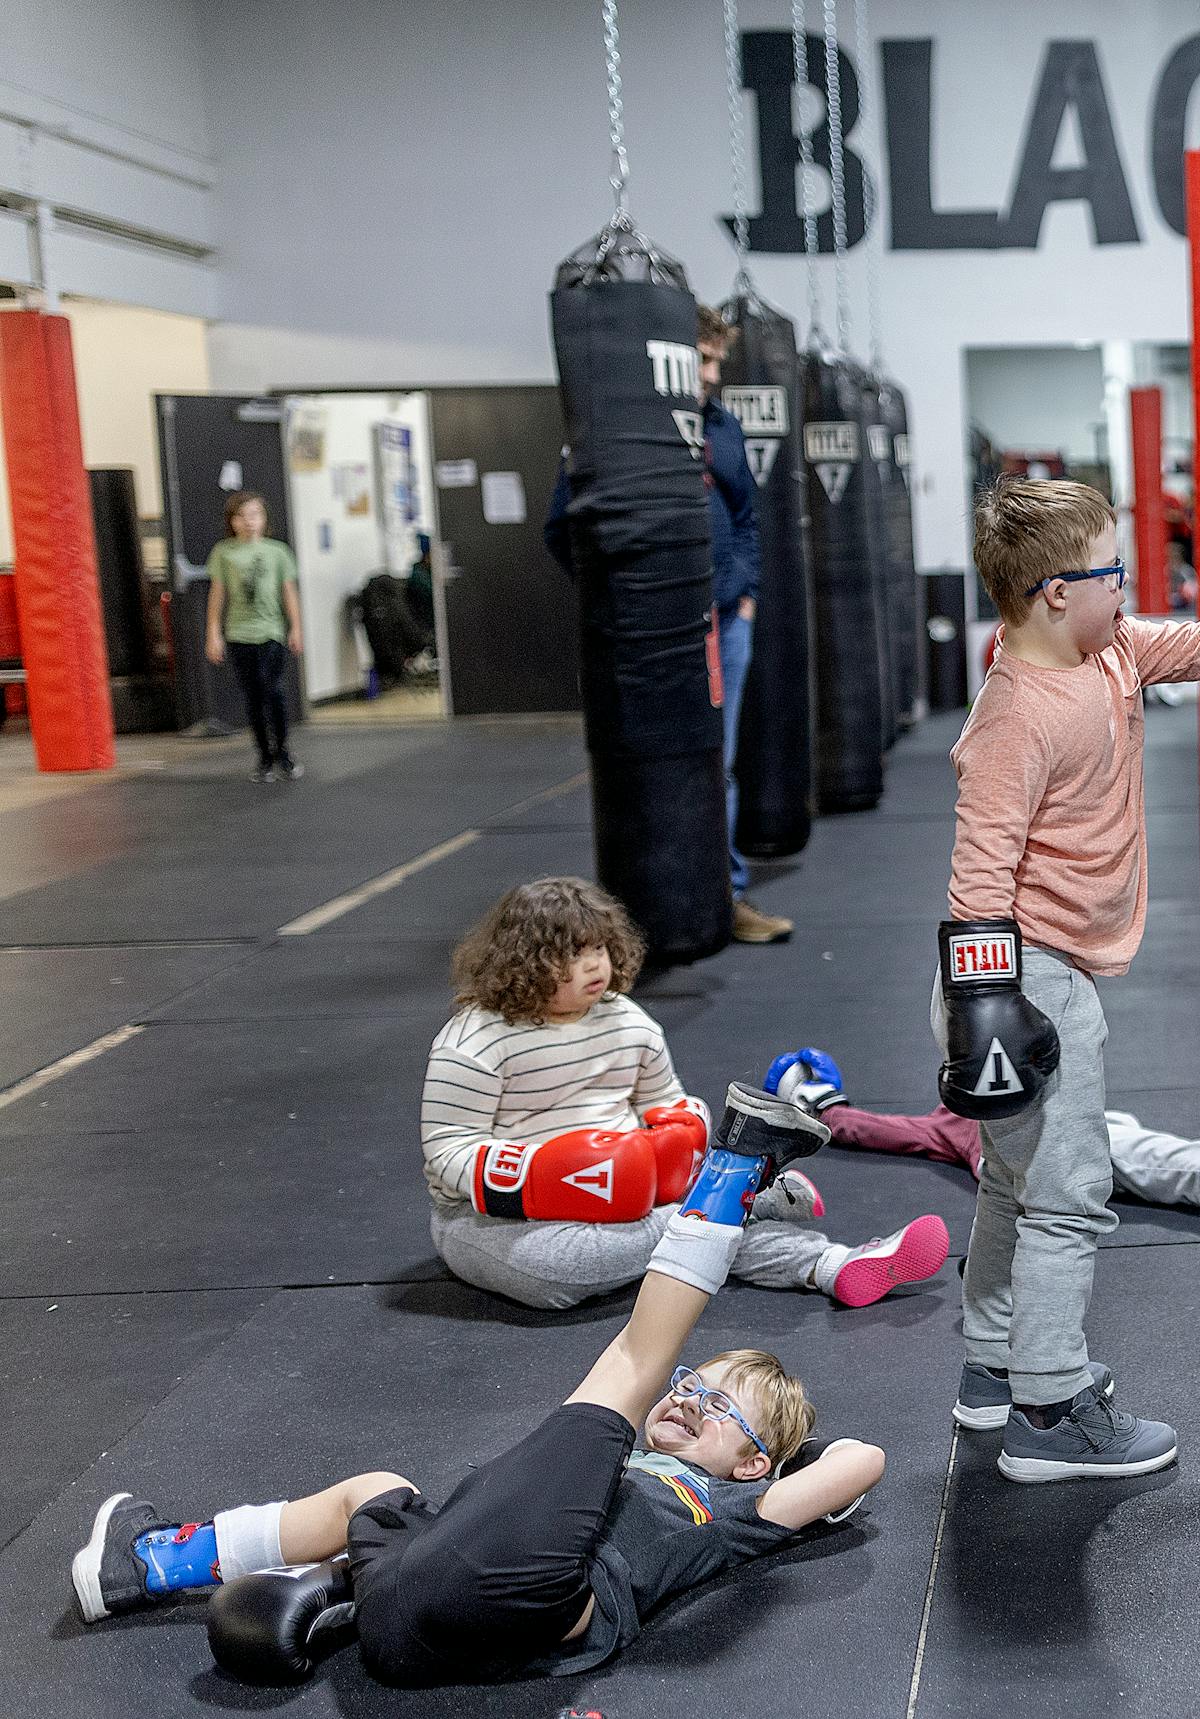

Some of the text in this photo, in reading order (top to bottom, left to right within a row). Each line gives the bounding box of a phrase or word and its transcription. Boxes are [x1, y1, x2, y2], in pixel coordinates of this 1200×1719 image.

[956, 943, 1010, 973] TITLE
[988, 1052, 1010, 1091] T
[573, 1171, 608, 1189] T
